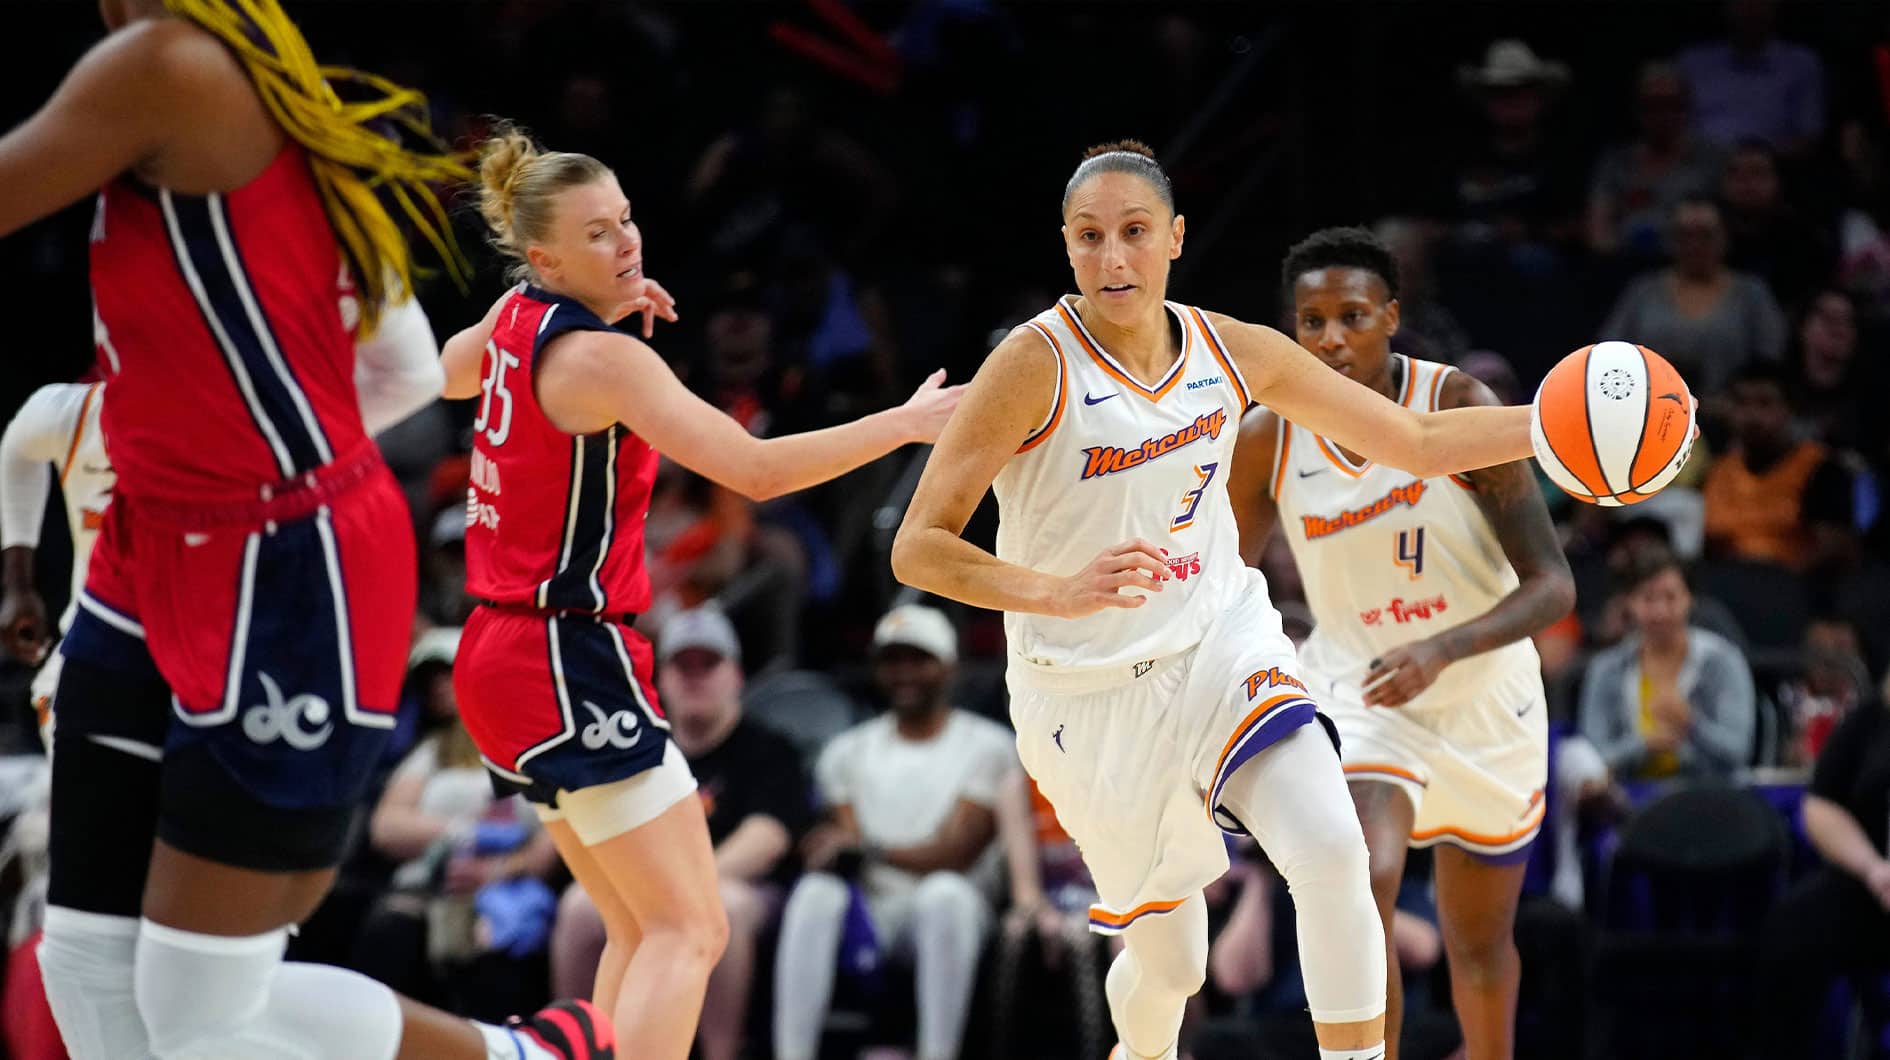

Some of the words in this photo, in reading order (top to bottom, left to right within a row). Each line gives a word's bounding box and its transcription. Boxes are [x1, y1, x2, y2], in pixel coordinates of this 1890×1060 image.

[474, 338, 519, 446] 35
[1081, 407, 1227, 480] Mercury
[1169, 462, 1218, 533] 3
[1300, 479, 1428, 541] Mercury
[1393, 527, 1424, 581] 4
